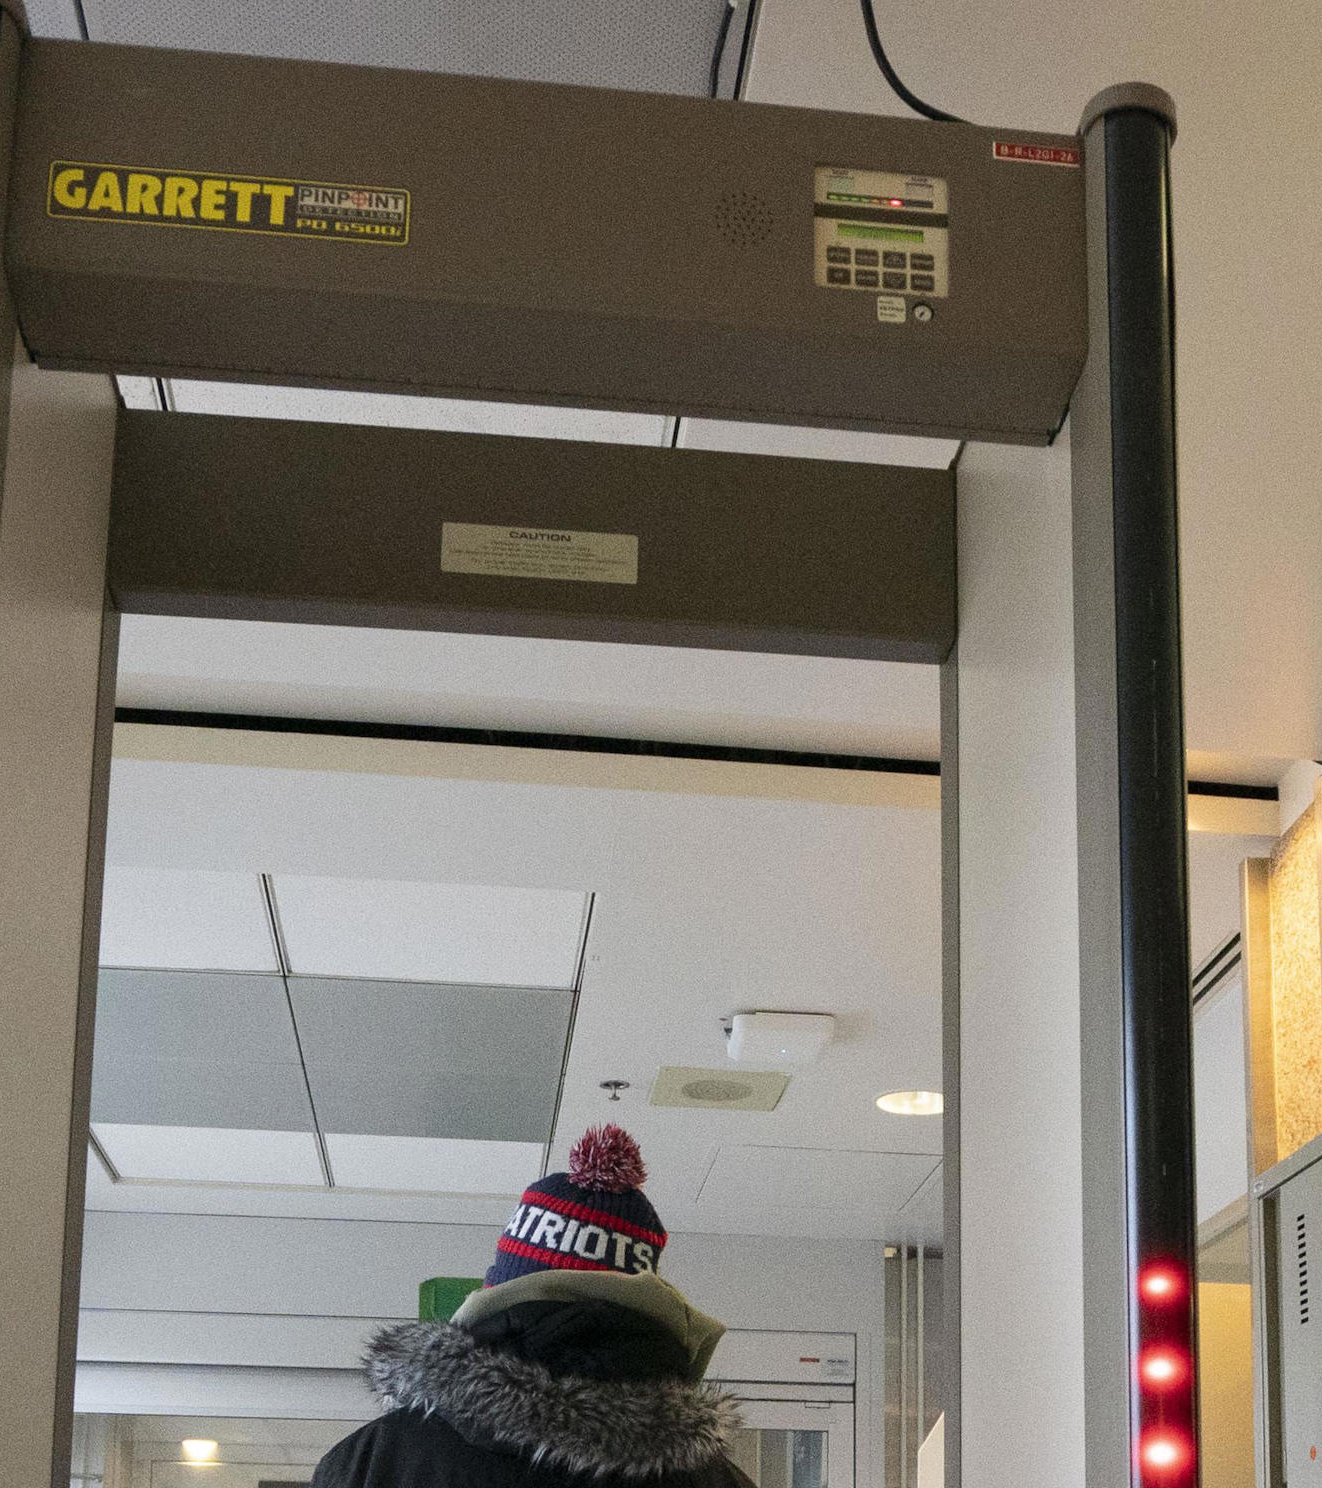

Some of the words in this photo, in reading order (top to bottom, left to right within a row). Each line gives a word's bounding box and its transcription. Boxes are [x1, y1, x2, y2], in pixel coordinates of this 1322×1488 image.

[53, 169, 294, 226] GARRETT
[300, 188, 402, 209] PINPOINT
[509, 530, 572, 543] CAUTION
[504, 1203, 654, 1275] ATRIOTS
